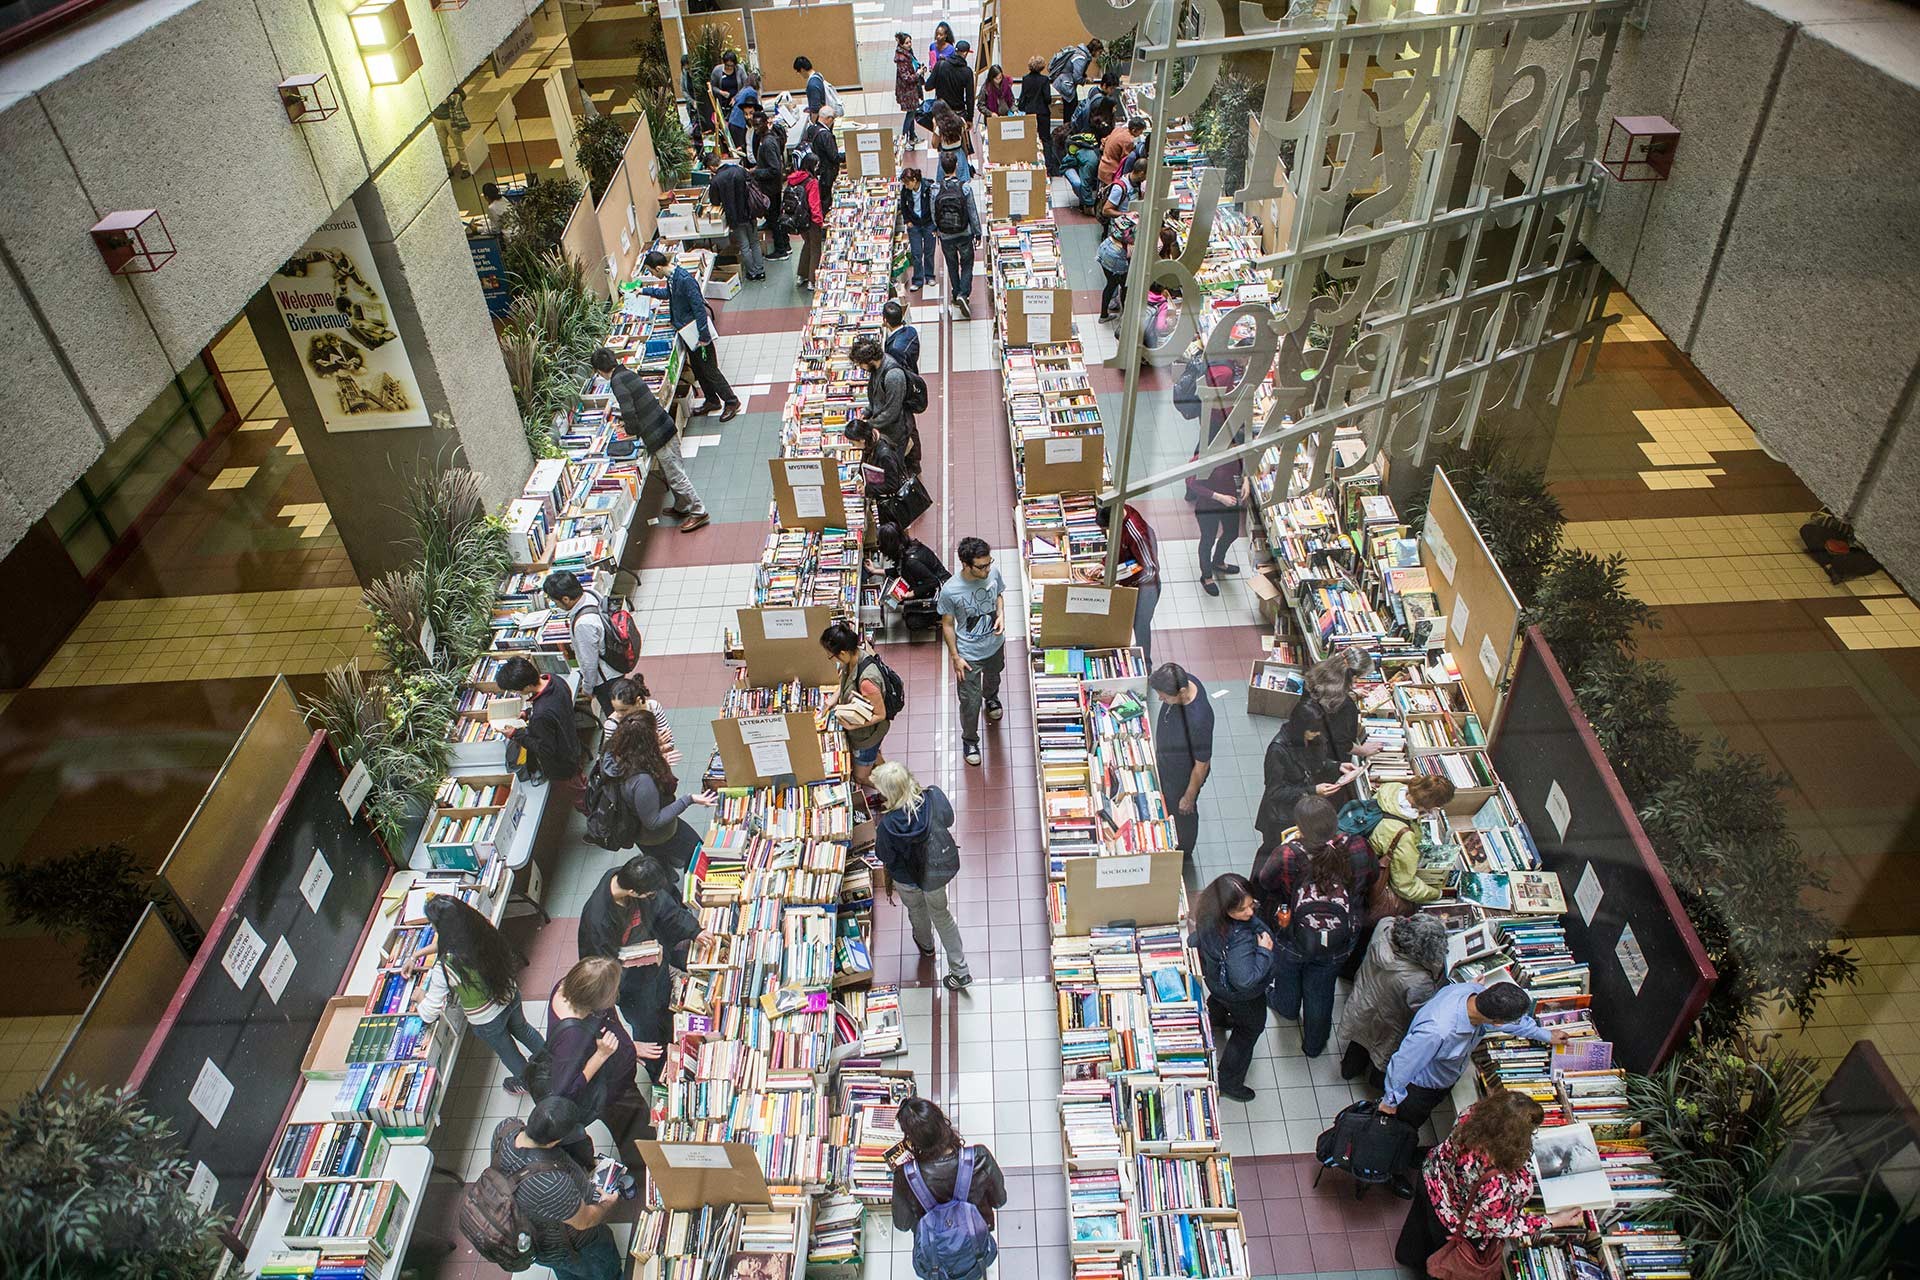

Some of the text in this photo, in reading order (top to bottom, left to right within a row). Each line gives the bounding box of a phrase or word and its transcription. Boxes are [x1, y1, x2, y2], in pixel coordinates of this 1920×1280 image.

[316, 220, 357, 232] ncordia
[276, 290, 334, 310] Welcome
[286, 312, 351, 332] Bienvenue
[739, 717, 783, 726] LITERATURE
[307, 868, 324, 898] PHYSICS
[1101, 866, 1144, 875] SOCIOLOGY
[228, 931, 244, 960] BIOLOGY
[230, 933, 251, 970] CHEMISTRY
[237, 944, 254, 972] PHYSICS
[242, 949, 259, 978] SCIENCE
[268, 953, 290, 990] CHEMISTRY
